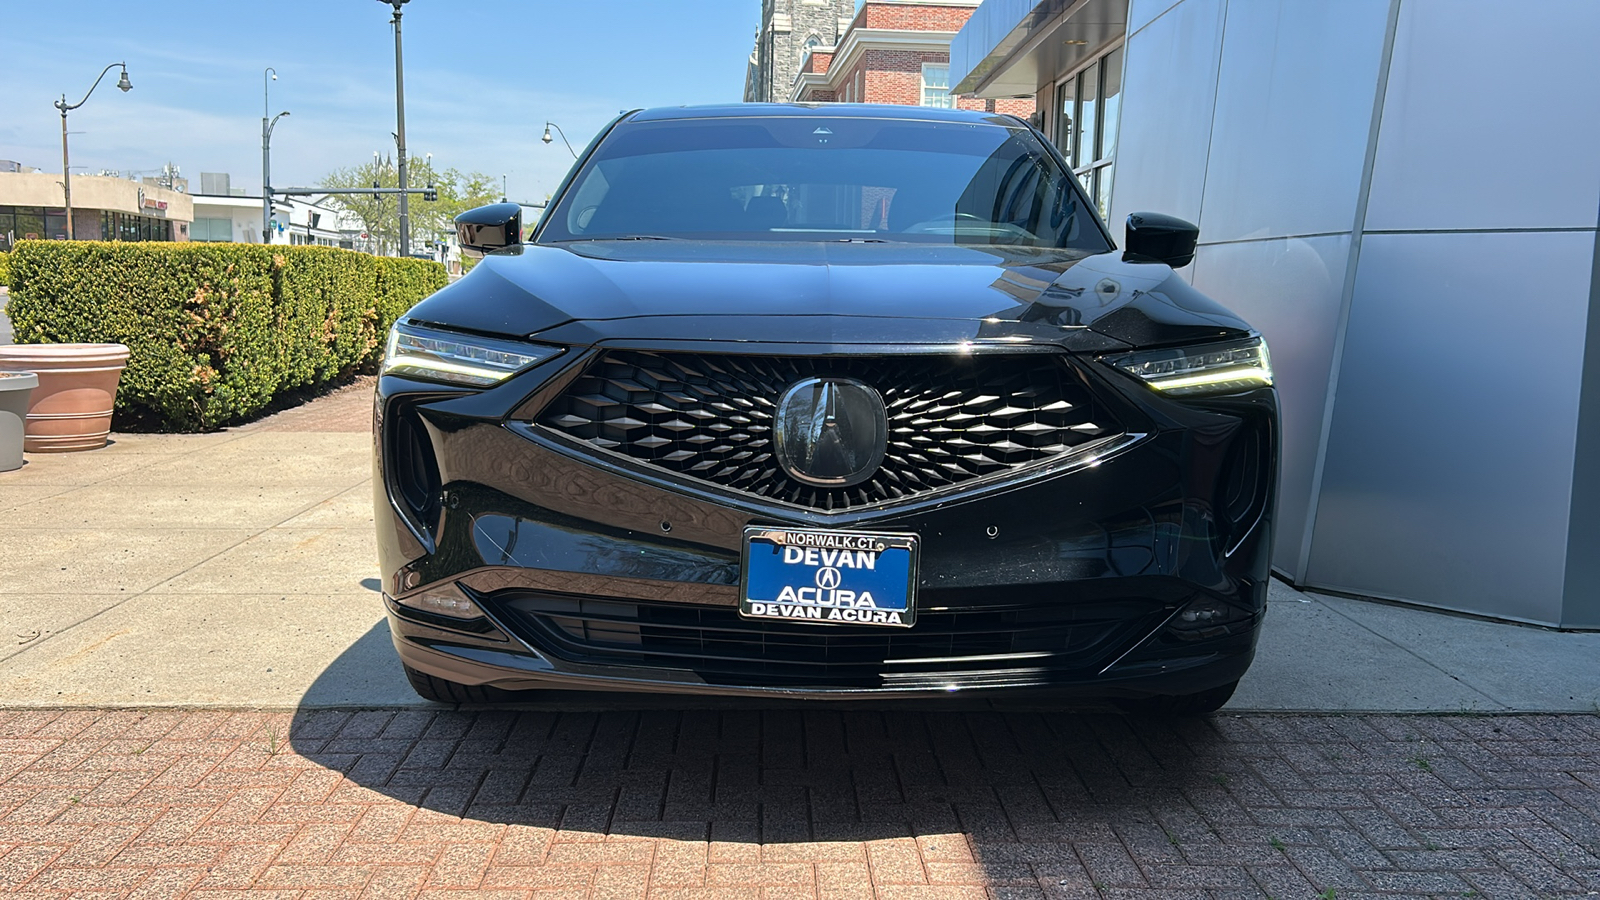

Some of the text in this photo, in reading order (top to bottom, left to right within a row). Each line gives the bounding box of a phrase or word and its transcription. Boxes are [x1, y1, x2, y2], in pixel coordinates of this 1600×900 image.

[786, 533, 876, 549] NORWALK, CT
[783, 546, 876, 569] DEVAN
[776, 586, 877, 608] ACURA
[751, 603, 902, 624] DEVAN ACURA
